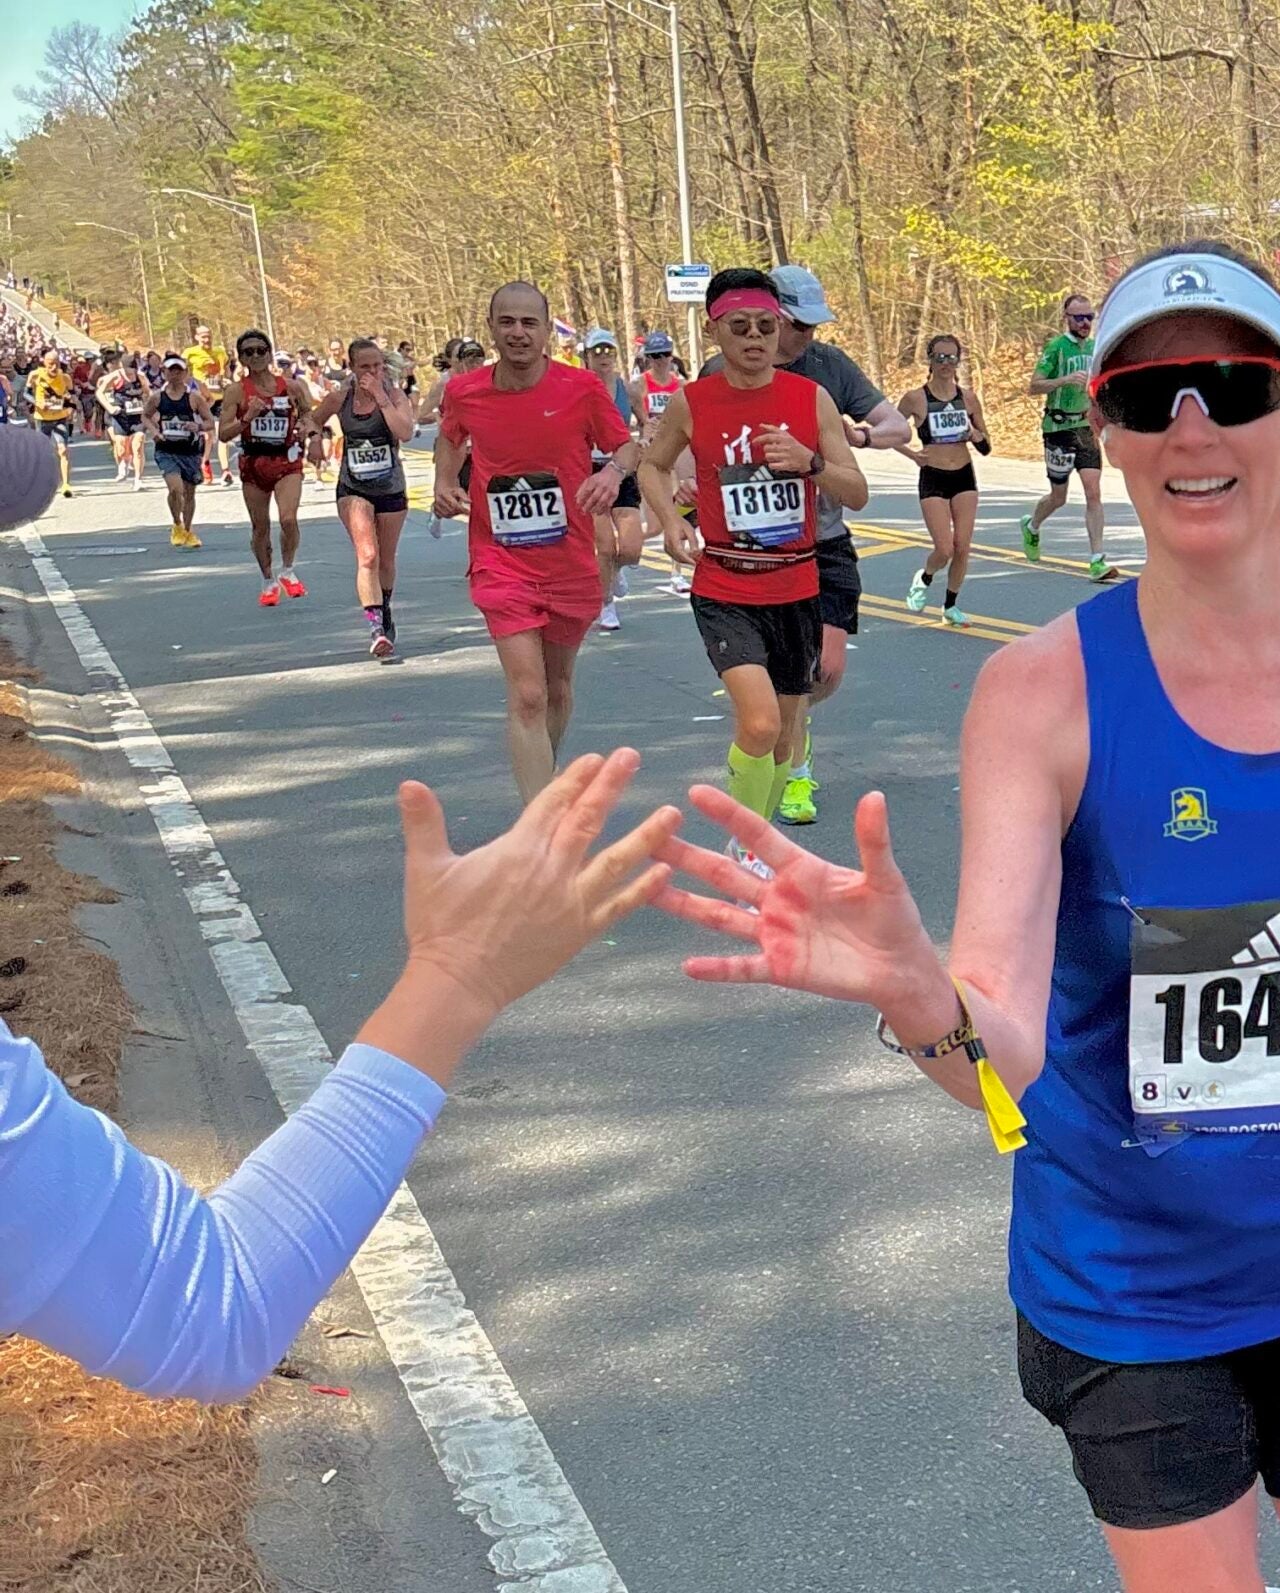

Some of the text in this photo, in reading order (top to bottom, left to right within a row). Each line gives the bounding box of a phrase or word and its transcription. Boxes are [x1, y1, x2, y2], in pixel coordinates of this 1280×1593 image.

[255, 418, 286, 432] 15137
[933, 411, 966, 429] 13836
[351, 448, 388, 465] 15552
[493, 491, 561, 521] 12812
[728, 481, 800, 517] 13130
[1141, 1081, 1159, 1101] 8
